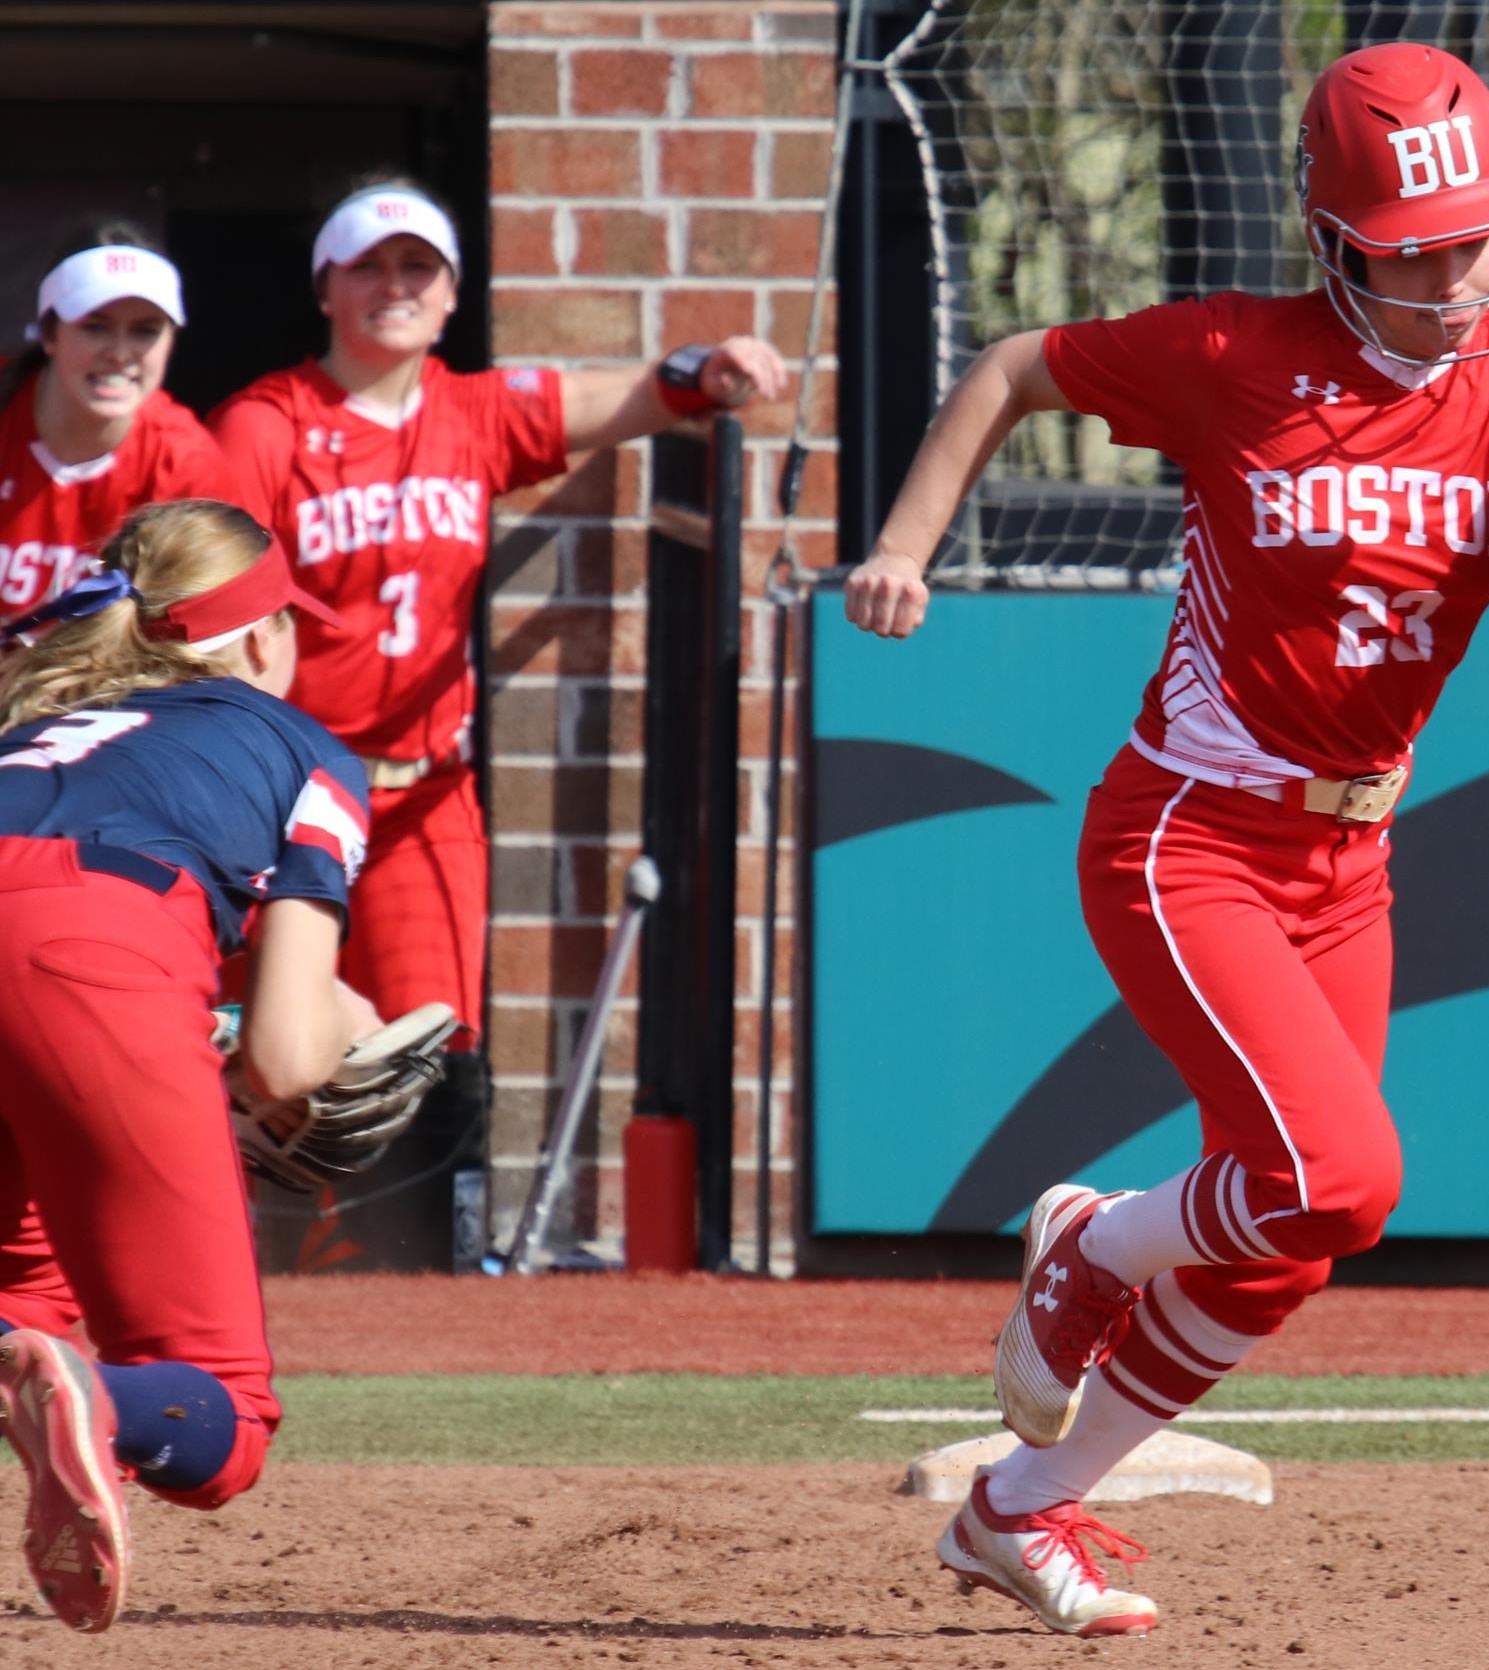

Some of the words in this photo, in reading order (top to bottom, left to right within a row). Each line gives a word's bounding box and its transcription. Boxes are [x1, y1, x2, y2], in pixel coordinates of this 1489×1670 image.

[1387, 114, 1480, 199] BU
[376, 201, 409, 219] BU
[105, 253, 138, 274] BU
[297, 476, 482, 567] BOSTON
[377, 571, 419, 657] 3
[1334, 584, 1446, 667] 23
